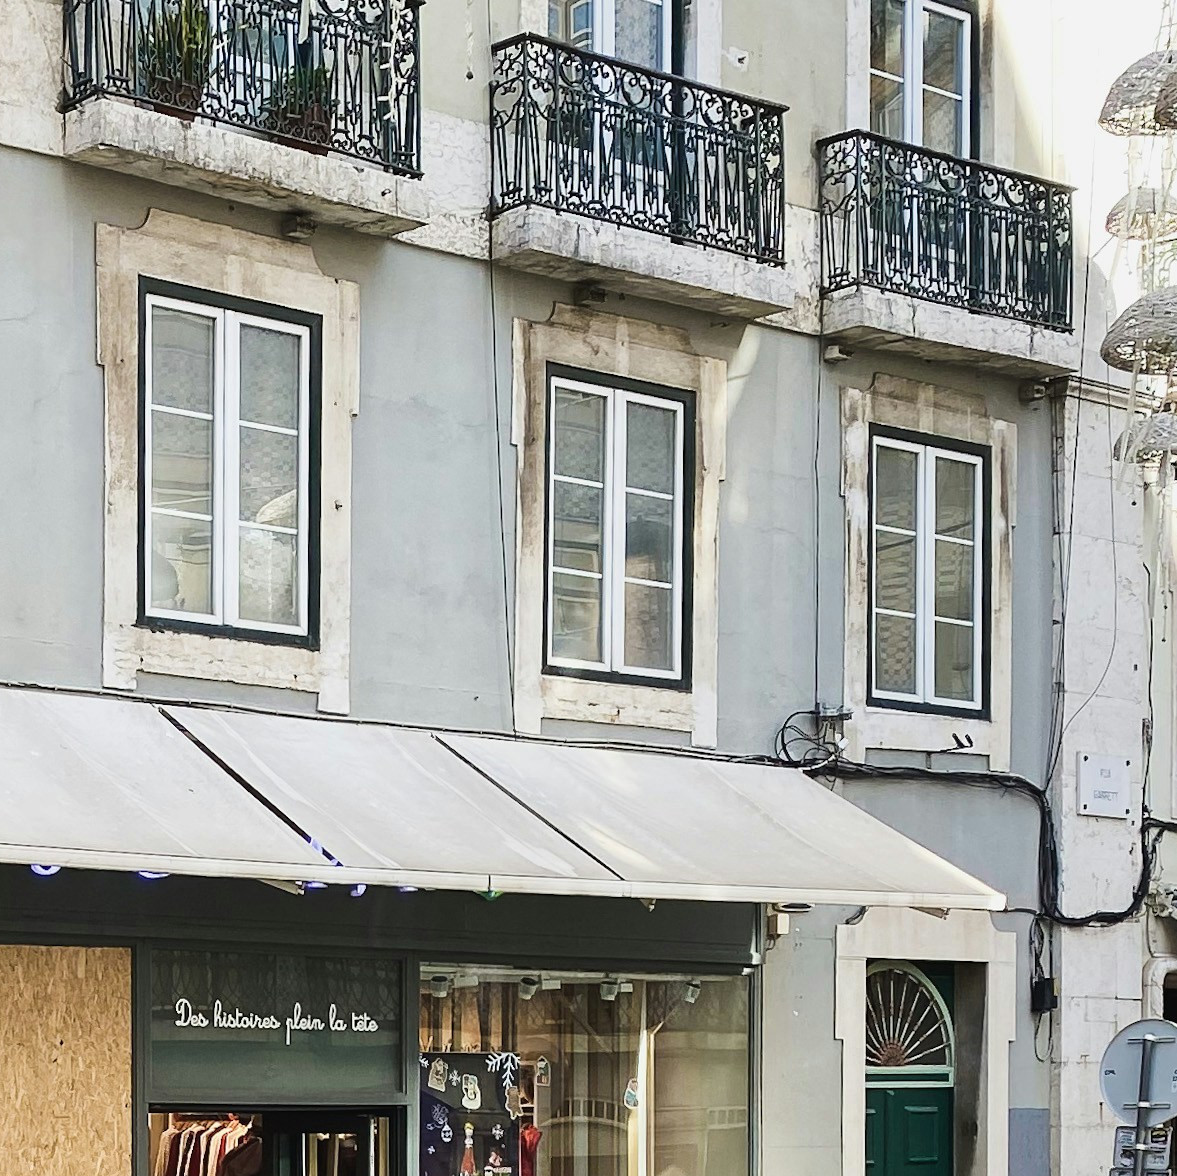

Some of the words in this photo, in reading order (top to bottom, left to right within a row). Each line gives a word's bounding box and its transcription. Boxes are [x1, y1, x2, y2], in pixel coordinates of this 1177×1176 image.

[175, 998, 209, 1028] Des
[213, 999, 281, 1029] histoires
[286, 1002, 325, 1046] plein
[329, 1003, 347, 1031] la
[351, 1012, 379, 1032] tête
